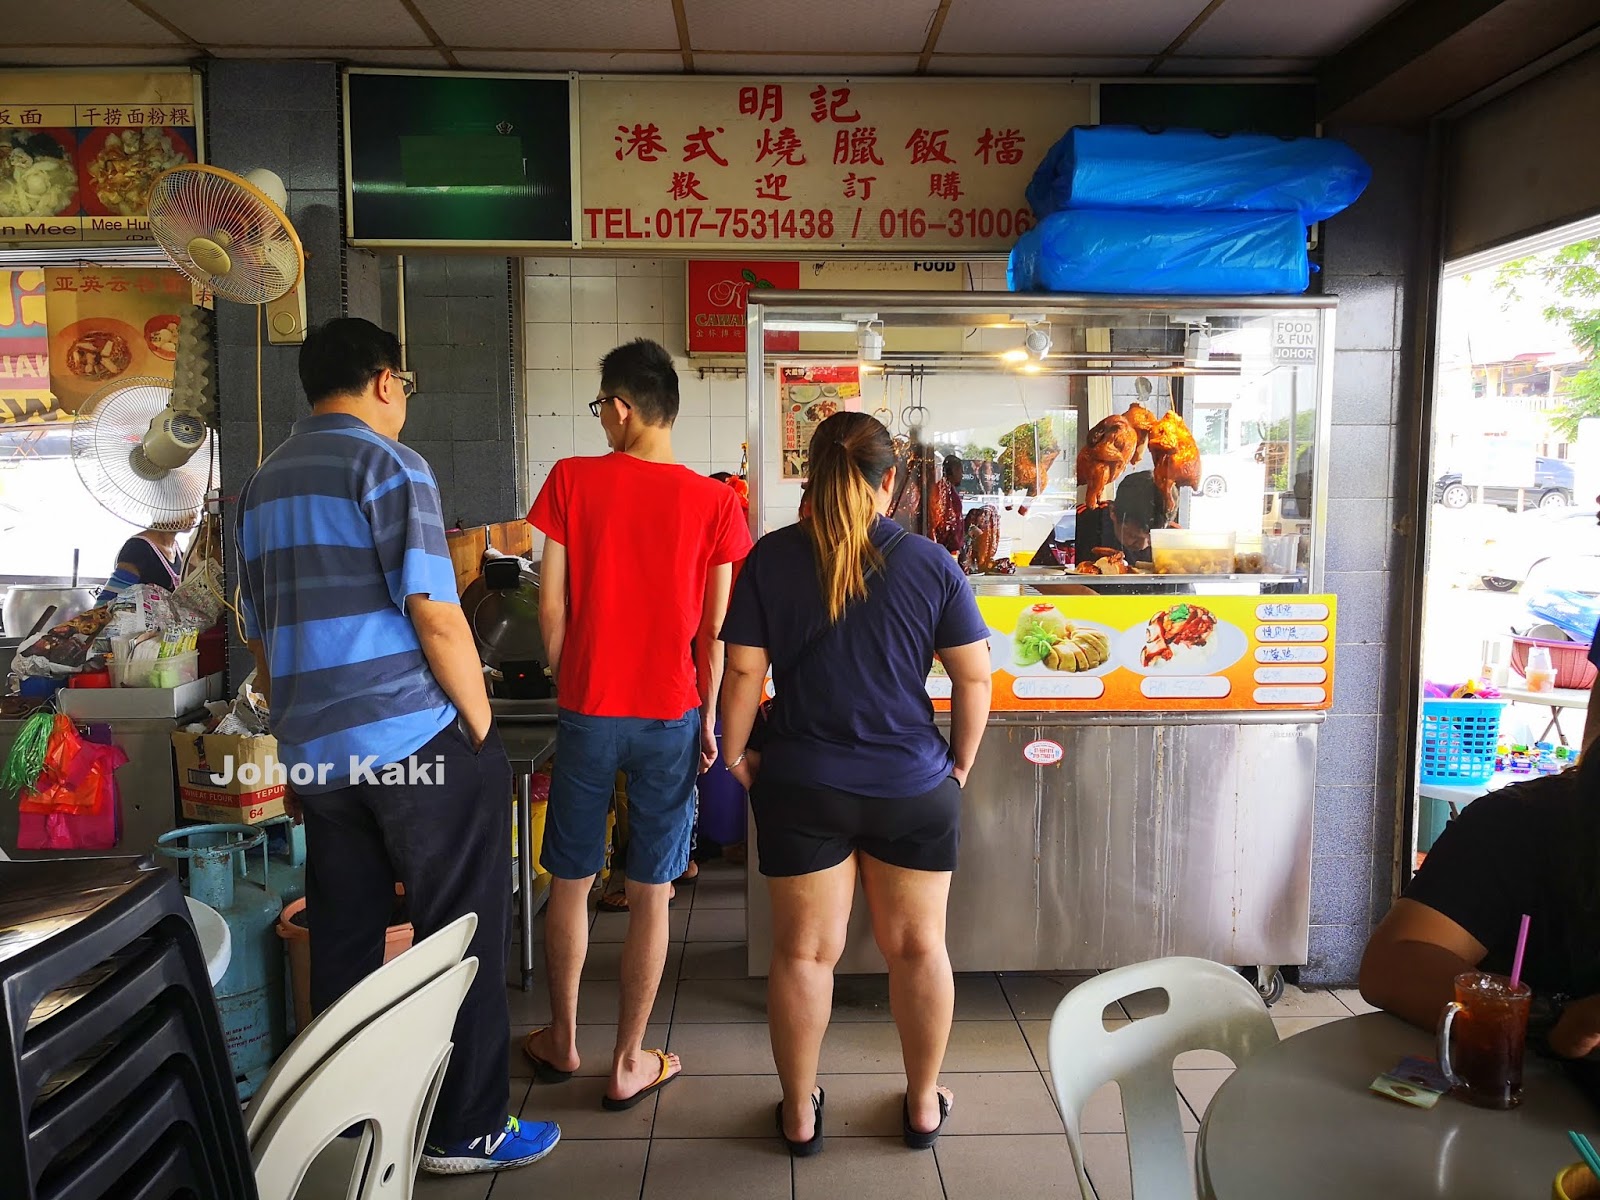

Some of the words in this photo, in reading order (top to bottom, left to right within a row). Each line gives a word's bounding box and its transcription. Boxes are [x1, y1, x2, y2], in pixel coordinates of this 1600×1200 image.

[739, 84, 861, 123] 明記
[666, 171, 965, 201] 歡迎訂購
[92, 218, 122, 231] Mee
[879, 207, 1033, 238] 016-31006
[26, 223, 77, 235] Mee
[1278, 322, 1312, 333] FOOD
[1277, 334, 1285, 345] &
[1289, 334, 1314, 345] FUN
[1275, 348, 1314, 359] JOHOR
[249, 807, 264, 819] 64
